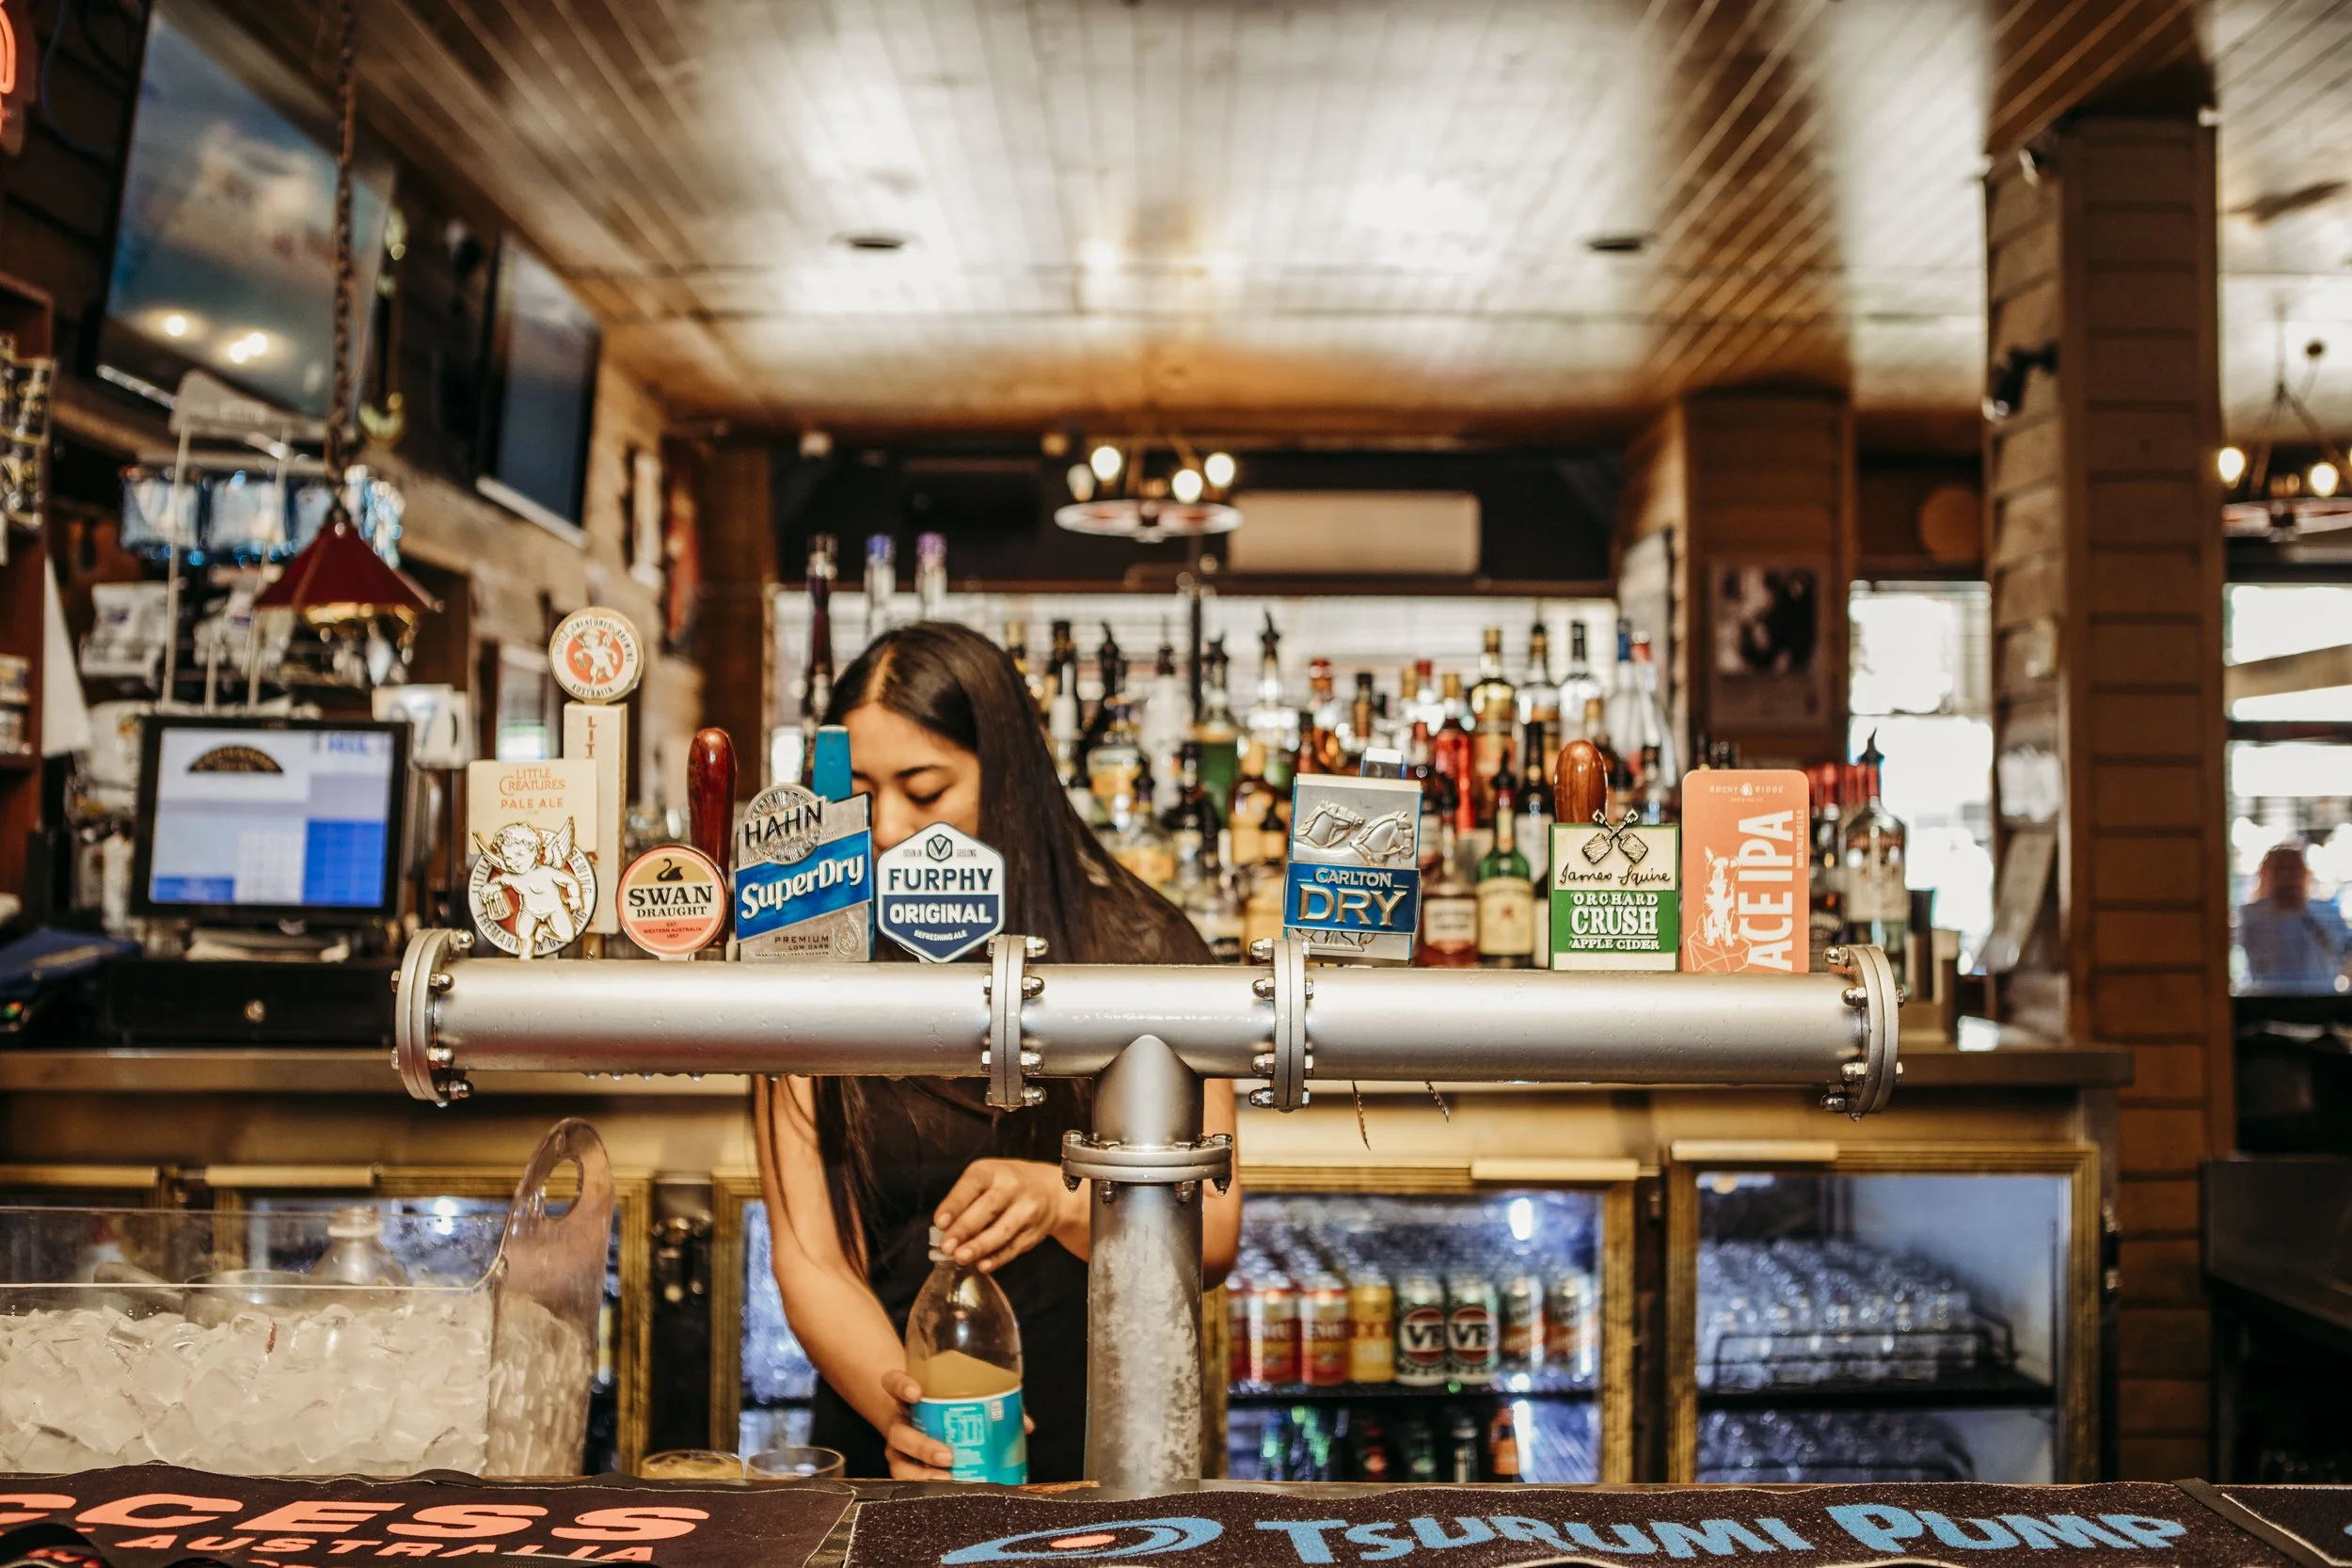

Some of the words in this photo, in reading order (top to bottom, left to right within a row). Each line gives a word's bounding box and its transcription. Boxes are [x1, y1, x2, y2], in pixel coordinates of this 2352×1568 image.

[571, 618, 612, 631] CREATURES
[616, 629, 633, 663] BREWING
[571, 684, 613, 697] AUSTRALIA
[516, 768, 552, 779] LITTLE
[499, 775, 565, 797] CREATURES
[1709, 785, 1738, 794] ROCKY
[1755, 785, 1784, 794] RIDGE
[501, 799, 533, 810] PALE
[539, 798, 564, 809] ALE
[744, 800, 822, 847] HAHN
[1738, 810, 1794, 882] IPA
[888, 868, 993, 891] FURPHY
[1314, 867, 1393, 888] CARLTON
[1560, 863, 1613, 885] James
[1618, 864, 1671, 886] Squire
[628, 885, 713, 908] SWAN
[1296, 883, 1408, 927] DRY
[1572, 893, 1659, 906] ORCHARD
[637, 906, 707, 919] DRAUGHT
[889, 902, 993, 925] ORIGINAL
[1570, 906, 1659, 936] CRUSH
[774, 935, 829, 943] PREMIUM
[914, 929, 954, 942] REFRESHING
[954, 929, 968, 940] ALE
[1739, 892, 1793, 972] ACE
[1570, 939, 1613, 950] APPLE
[1616, 939, 1661, 951] CIDER
[1825, 1502, 2188, 1553] PUMP
